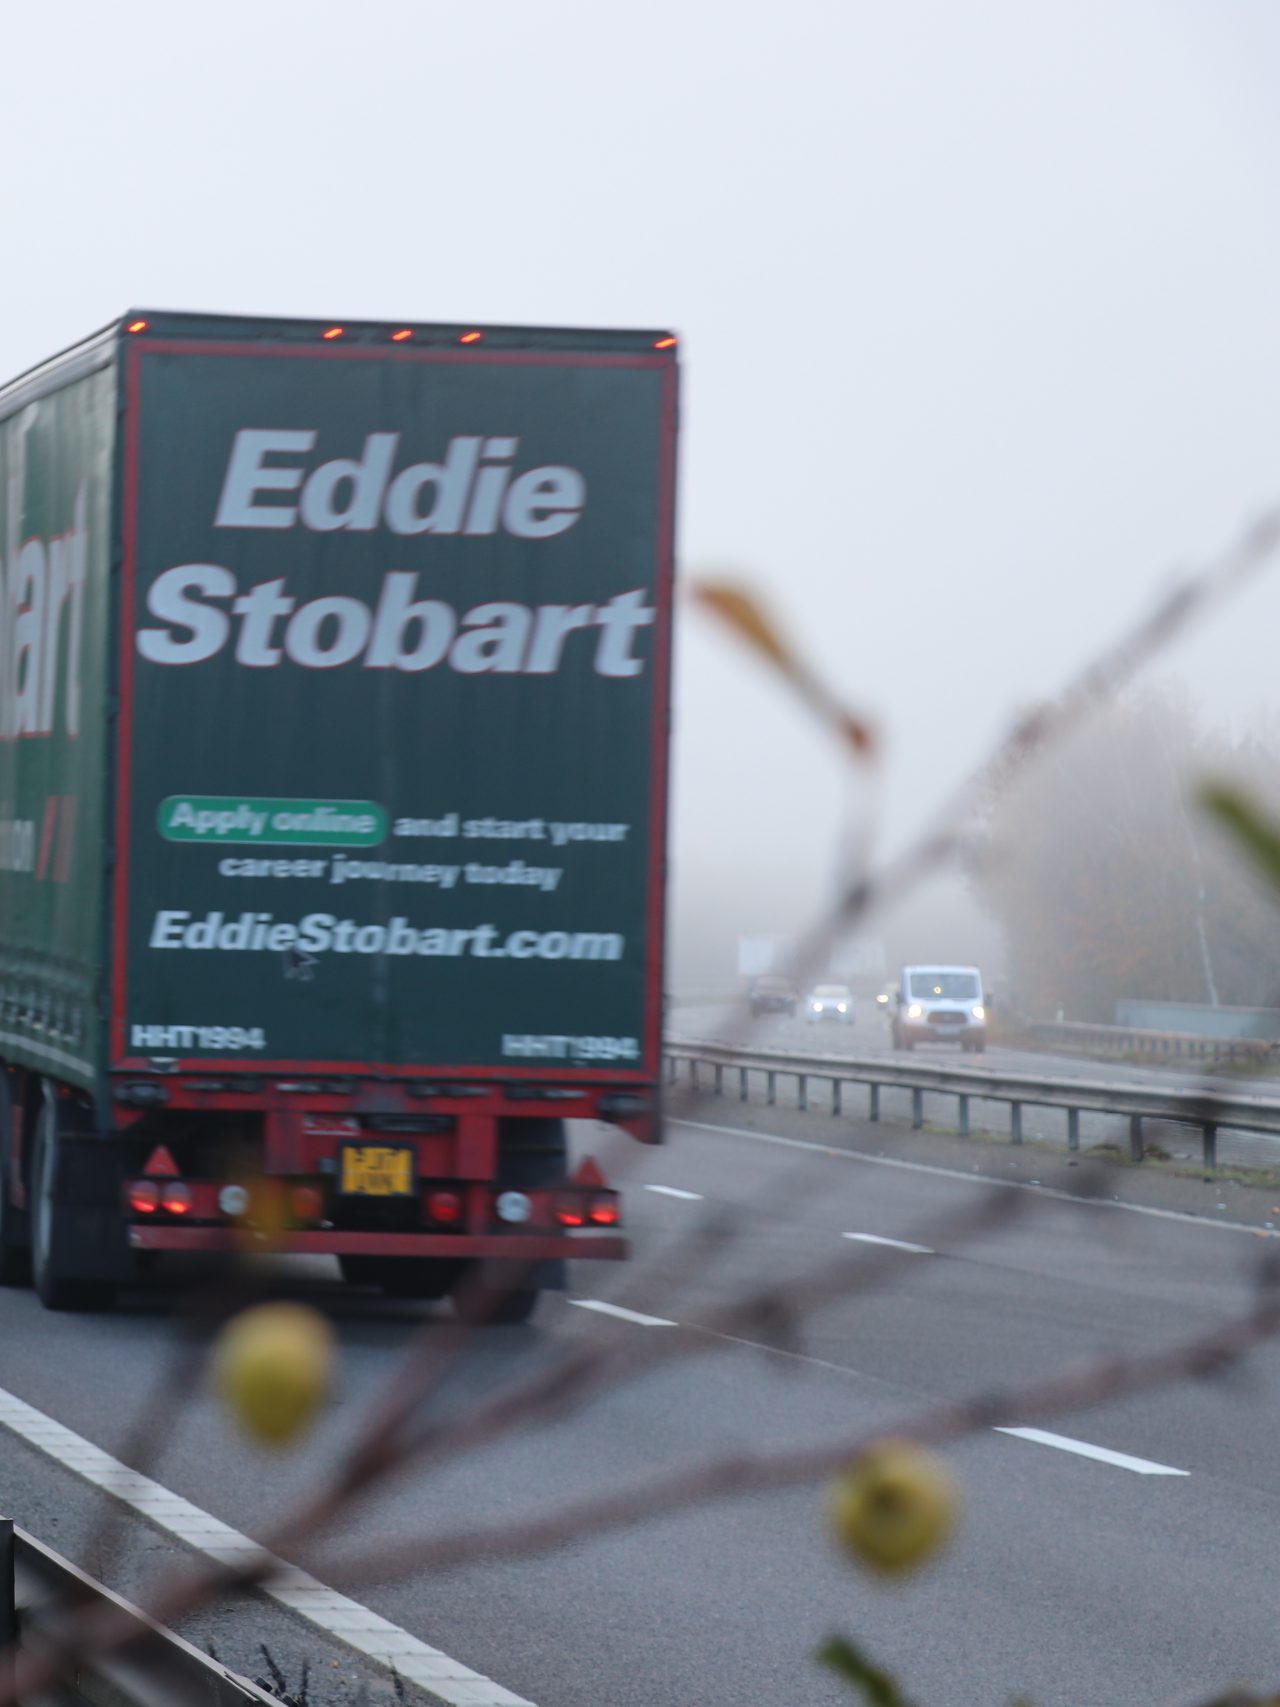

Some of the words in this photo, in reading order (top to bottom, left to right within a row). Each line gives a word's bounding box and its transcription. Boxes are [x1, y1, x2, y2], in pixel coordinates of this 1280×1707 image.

[215, 428, 585, 538] Eddie
[136, 563, 656, 677] Stobart
[168, 802, 268, 836] Apply
[272, 806, 377, 833] online
[393, 812, 459, 838] and
[462, 816, 547, 840] start
[549, 822, 630, 846] your
[218, 858, 328, 878] career
[329, 853, 461, 889] journey
[464, 860, 563, 891] today
[150, 910, 624, 961] EddieStobart.com
